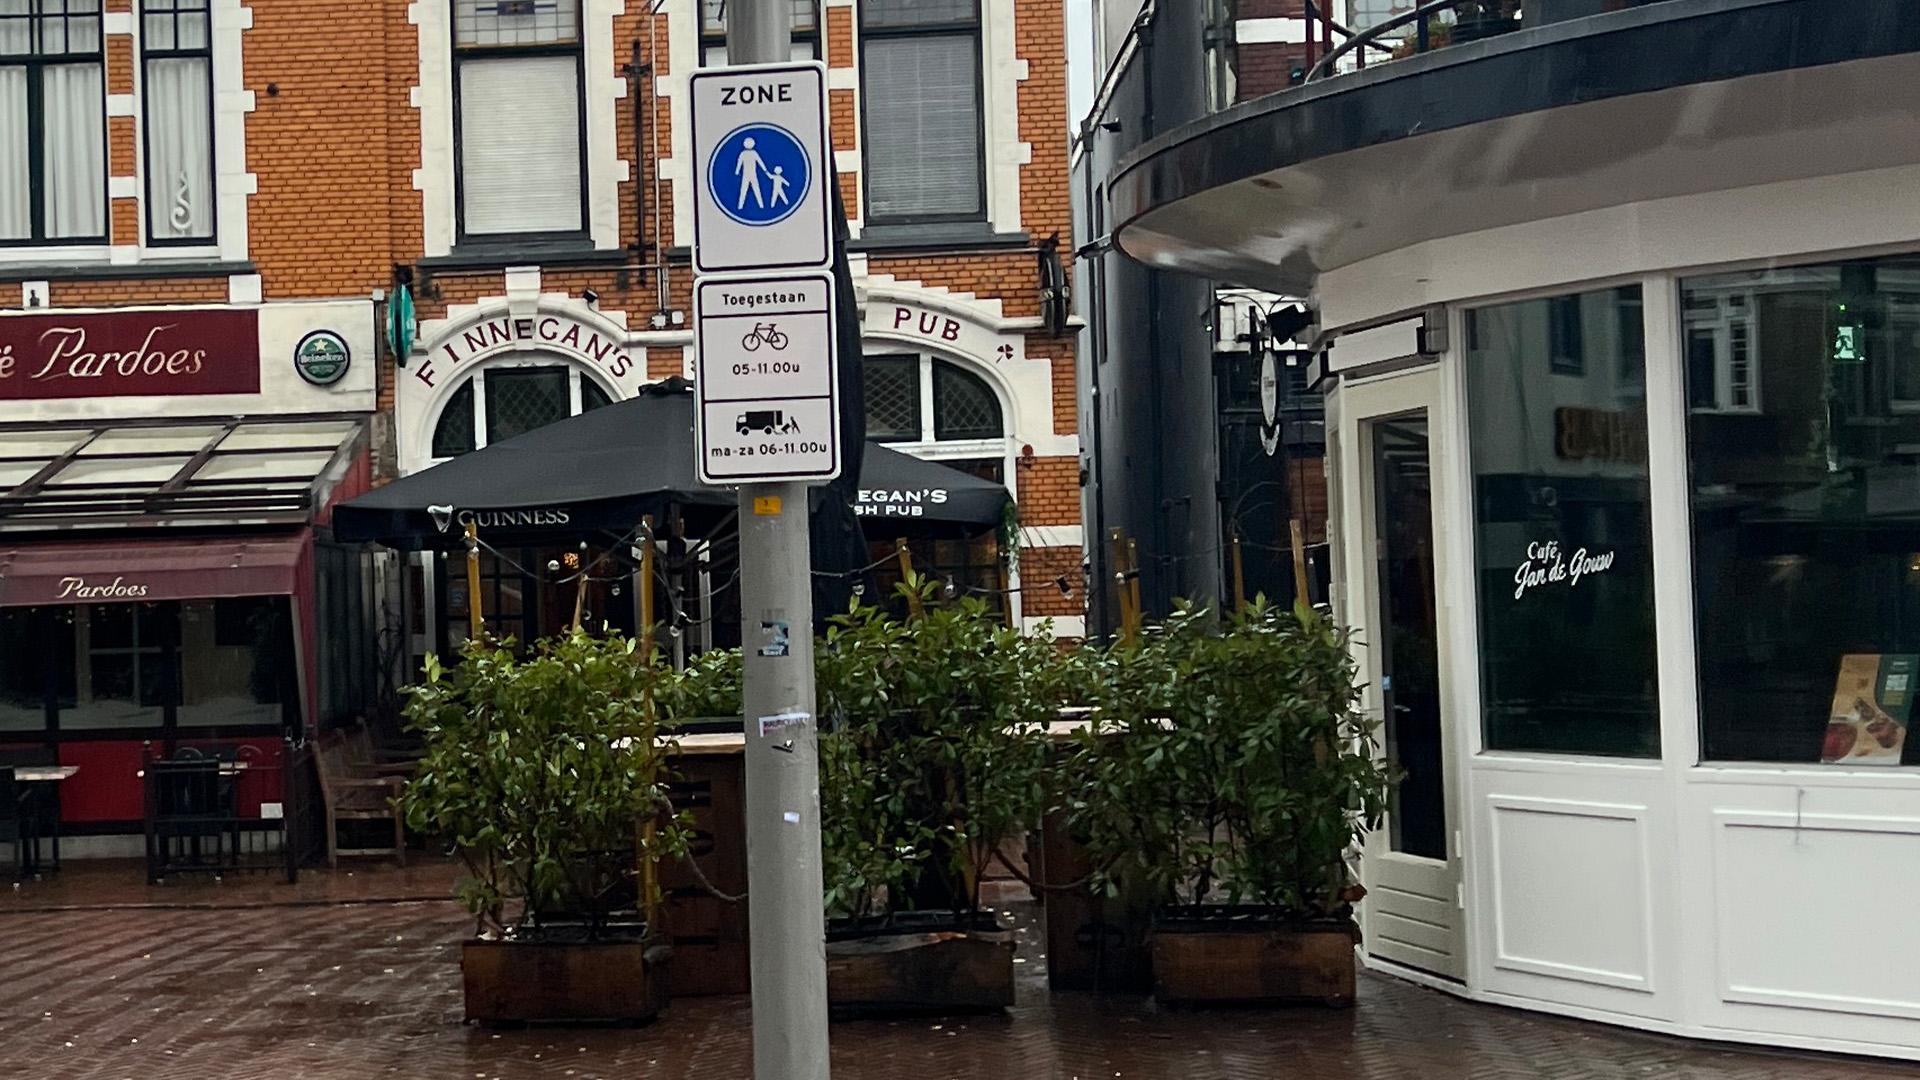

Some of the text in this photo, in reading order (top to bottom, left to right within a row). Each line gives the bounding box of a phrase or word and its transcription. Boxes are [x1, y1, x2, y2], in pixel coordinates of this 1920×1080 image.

[721, 83, 792, 106] ZONE
[722, 292, 806, 308] Toegestaan
[893, 307, 961, 341] PUB
[31, 323, 206, 381] Pardoes
[415, 317, 634, 388] FINNEGAN'S
[732, 362, 800, 376] 05-11.00u
[711, 441, 827, 457] ma-za 06-11.00u
[457, 508, 570, 528] GUINNESS
[885, 505, 923, 516] PUB
[1527, 540, 1558, 564] Café
[1514, 547, 1614, 600] Jan de Gouw
[56, 576, 148, 599] Pardoes
